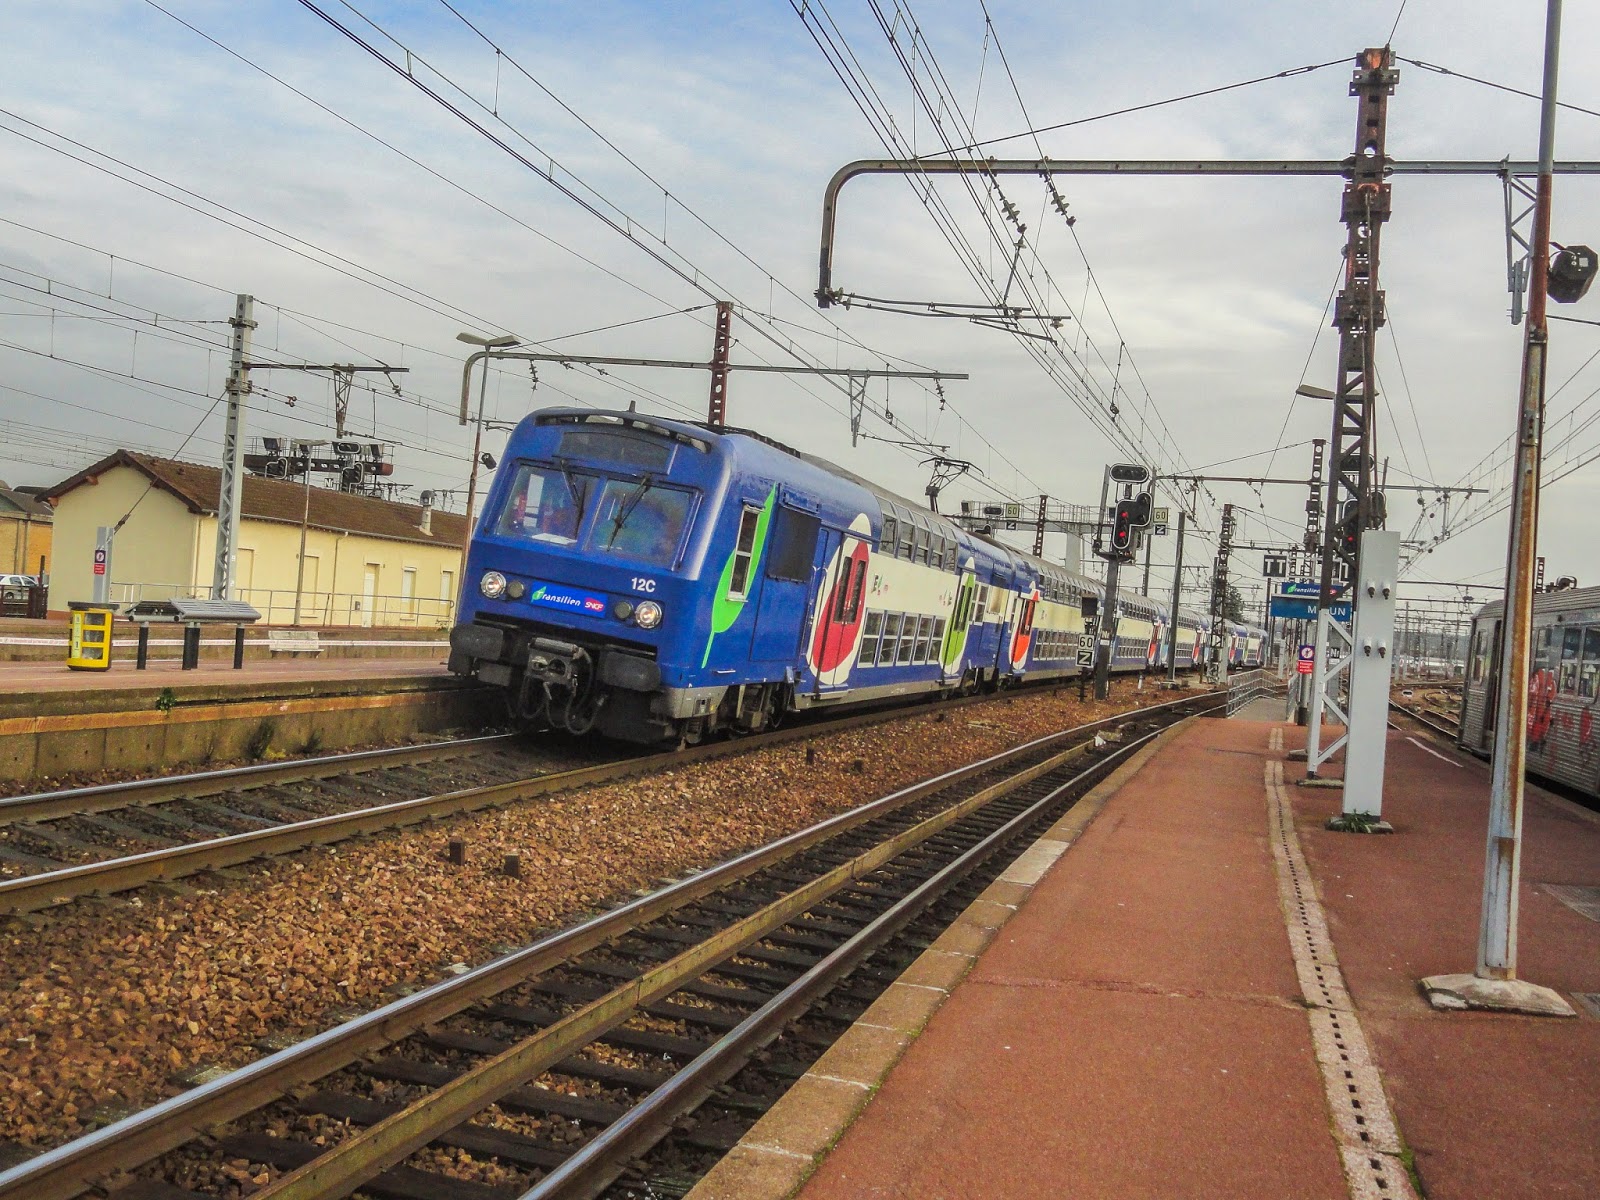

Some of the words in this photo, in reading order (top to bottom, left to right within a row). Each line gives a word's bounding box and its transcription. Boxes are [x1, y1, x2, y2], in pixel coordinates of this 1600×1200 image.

[1007, 506, 1017, 515] 60
[1155, 511, 1166, 520] 60
[631, 577, 656, 593] 12C
[535, 588, 581, 607] Transilien
[584, 600, 604, 612] SNCF
[1307, 605, 1346, 616] MUN
[1080, 636, 1093, 648] 60
[1078, 651, 1091, 665] Z
